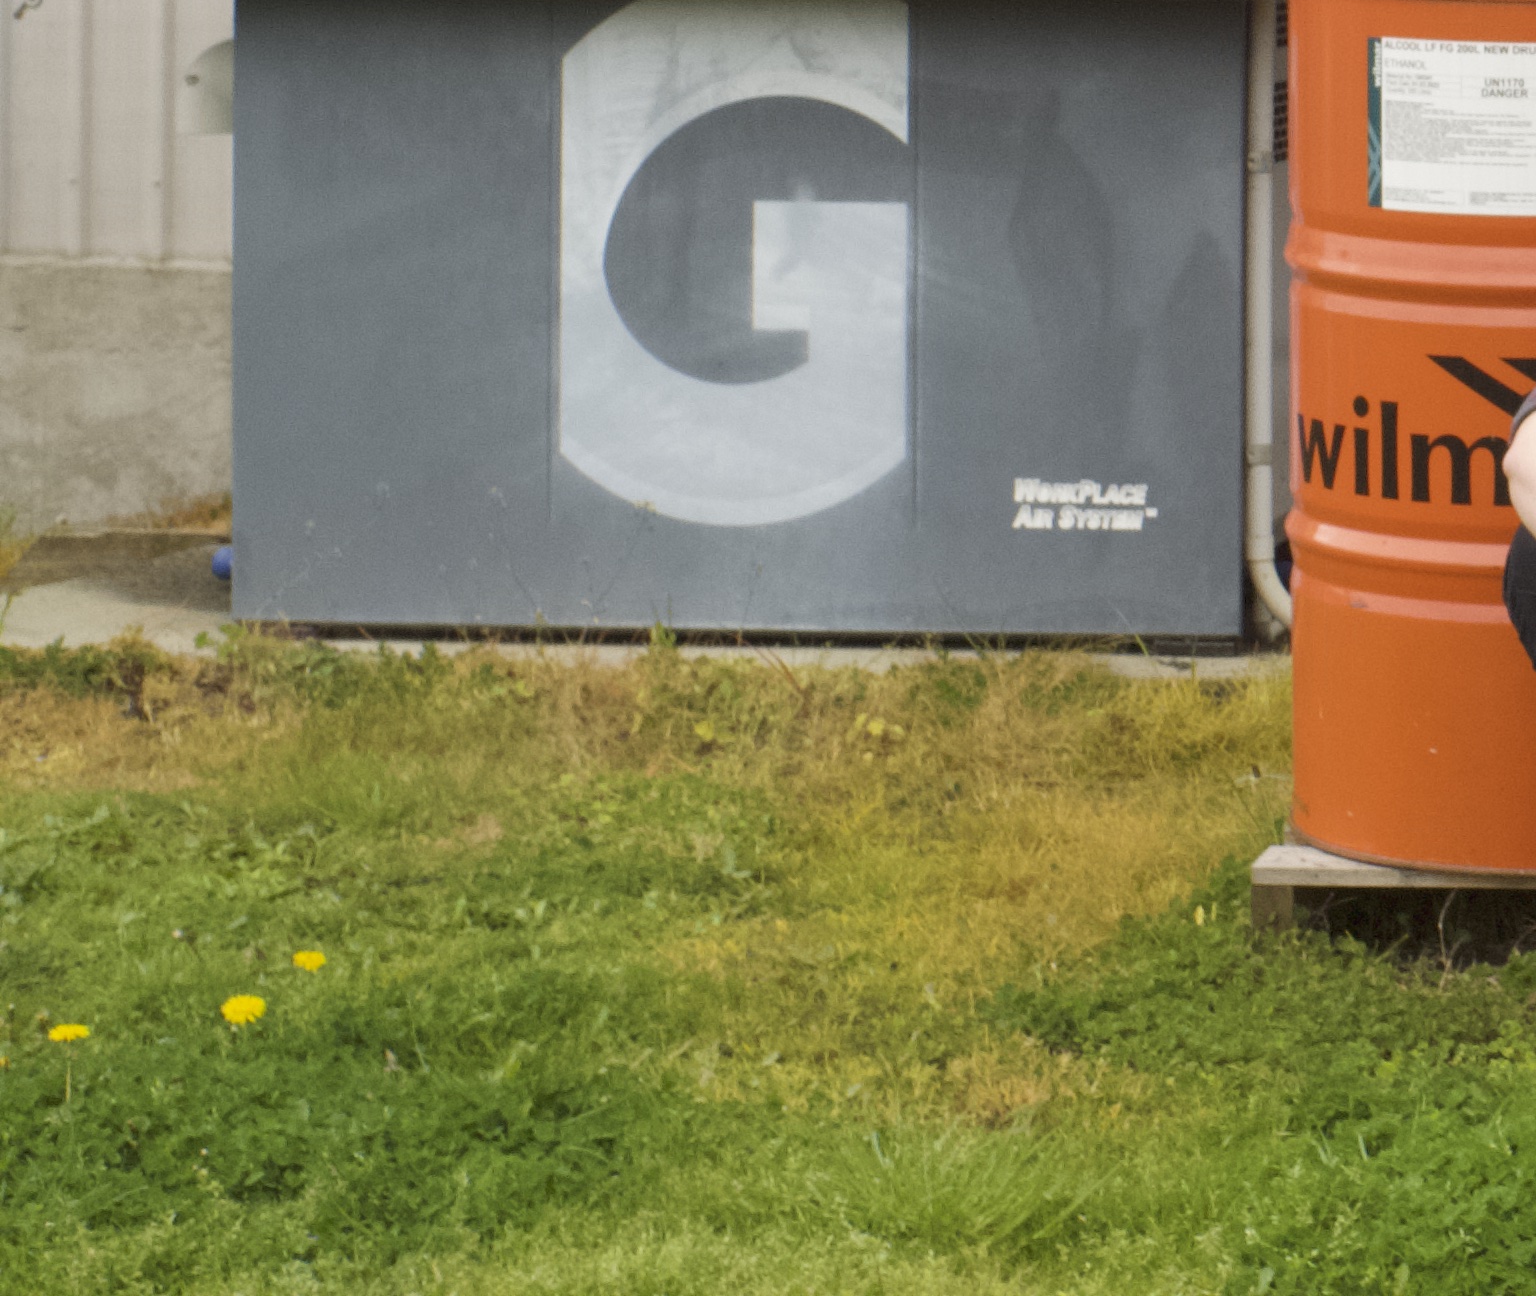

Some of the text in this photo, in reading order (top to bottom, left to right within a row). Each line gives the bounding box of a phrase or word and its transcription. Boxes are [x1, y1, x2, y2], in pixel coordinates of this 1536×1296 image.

[1384, 41, 1421, 52] ALCOOL
[1425, 42, 1436, 52] LF
[1440, 43, 1454, 53] FG
[1484, 44, 1509, 54] NEW
[1384, 59, 1427, 71] ETHANOL
[1484, 78, 1525, 88] UN1170
[1481, 88, 1529, 98] DANGER
[1298, 395, 1511, 507] wilm
